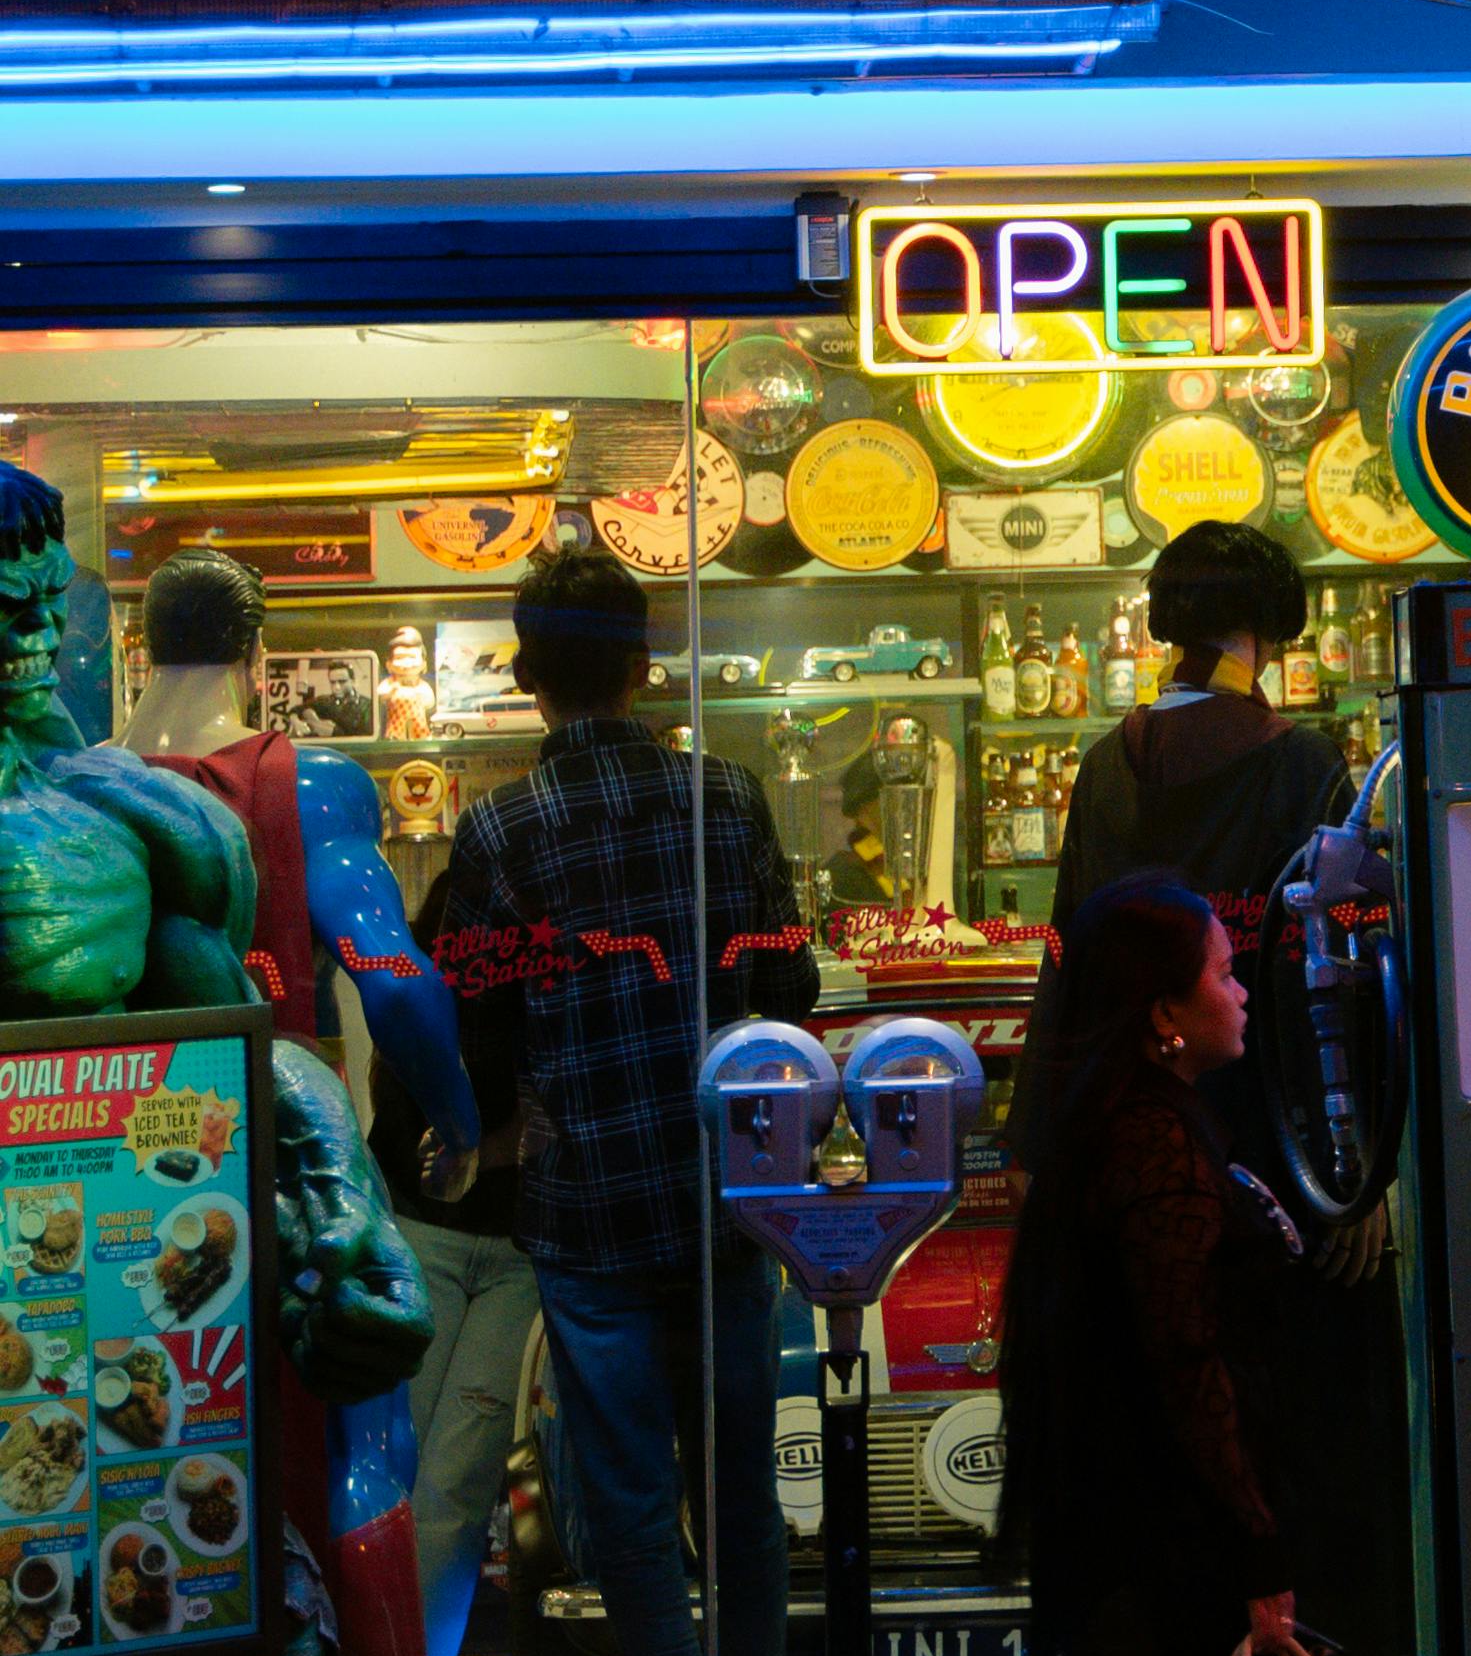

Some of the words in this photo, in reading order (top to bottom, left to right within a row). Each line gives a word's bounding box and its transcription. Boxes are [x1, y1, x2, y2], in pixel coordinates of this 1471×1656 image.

[879, 214, 1302, 359] OPEN
[1158, 451, 1244, 483] SHELL
[1002, 520, 1046, 539] MINI
[827, 904, 916, 946] Filling
[431, 921, 527, 971] Filling
[855, 936, 978, 974] Station
[458, 951, 590, 999] Station
[74, 1050, 158, 1095] PLATE
[7, 1097, 113, 1136] SPECIALS
[133, 1115, 162, 1133] ICED
[164, 1112, 187, 1129] TEA
[189, 1111, 199, 1127] &
[140, 1096, 175, 1114] SERVED
[177, 1095, 203, 1108] WITH
[15, 1149, 55, 1166] MONDAY
[56, 1148, 69, 1162] TO
[69, 1145, 118, 1162] THURSDAY
[135, 1129, 199, 1149] BROWNIES
[42, 1163, 60, 1178] AM
[61, 1162, 75, 1177] TO
